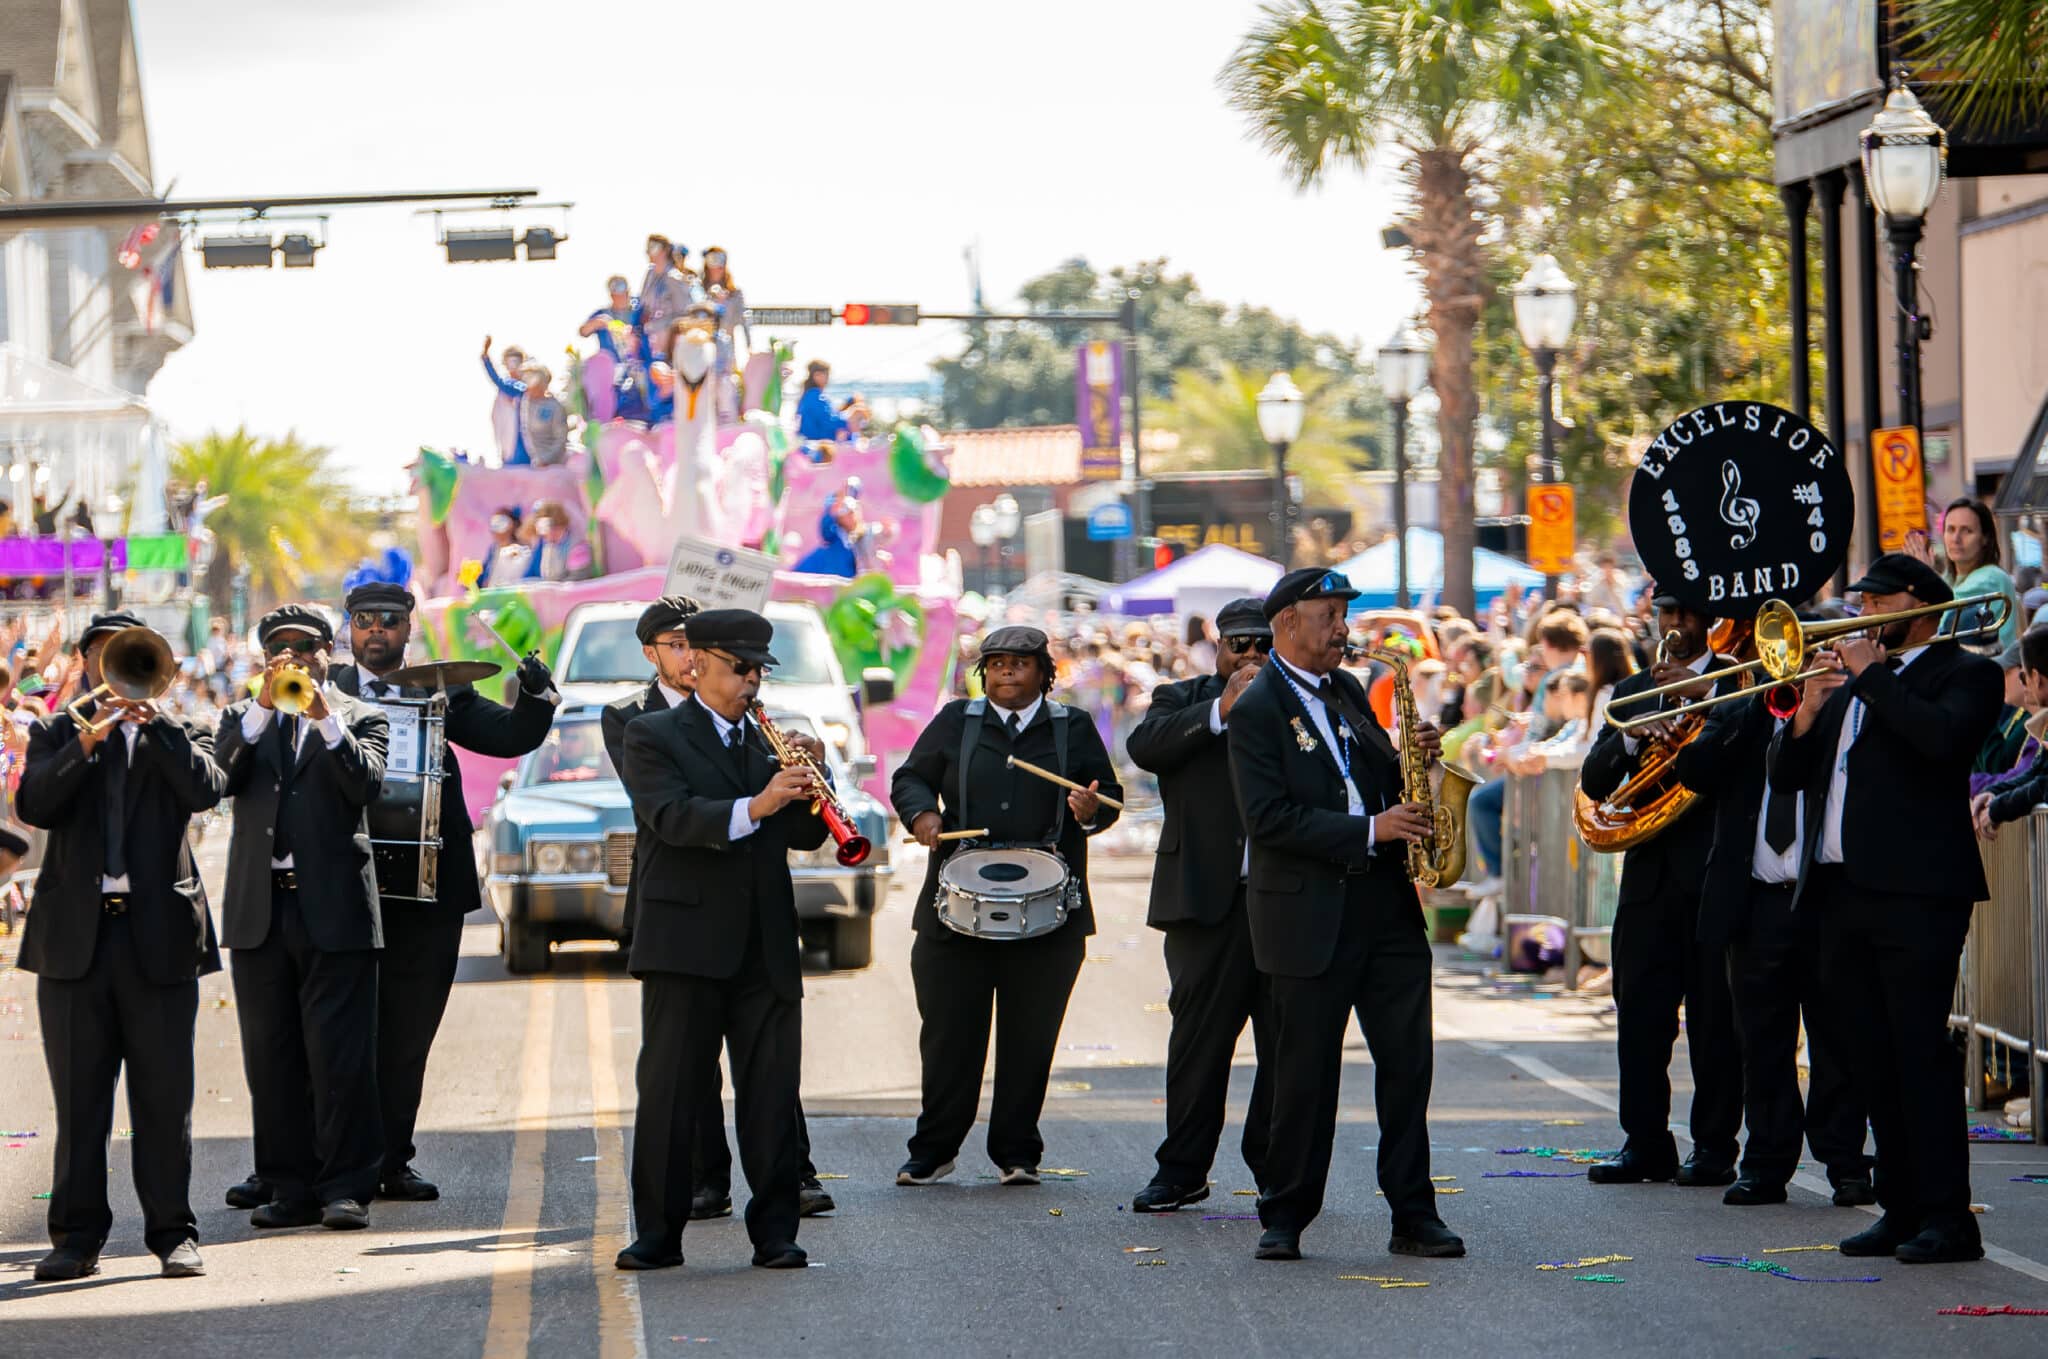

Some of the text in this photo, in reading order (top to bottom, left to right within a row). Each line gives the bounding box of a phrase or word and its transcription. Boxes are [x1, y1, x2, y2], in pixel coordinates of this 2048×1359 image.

[1638, 404, 1834, 480] EXCELSIOR
[1661, 489, 1700, 581] 1883
[1708, 562, 1800, 601] BAND
